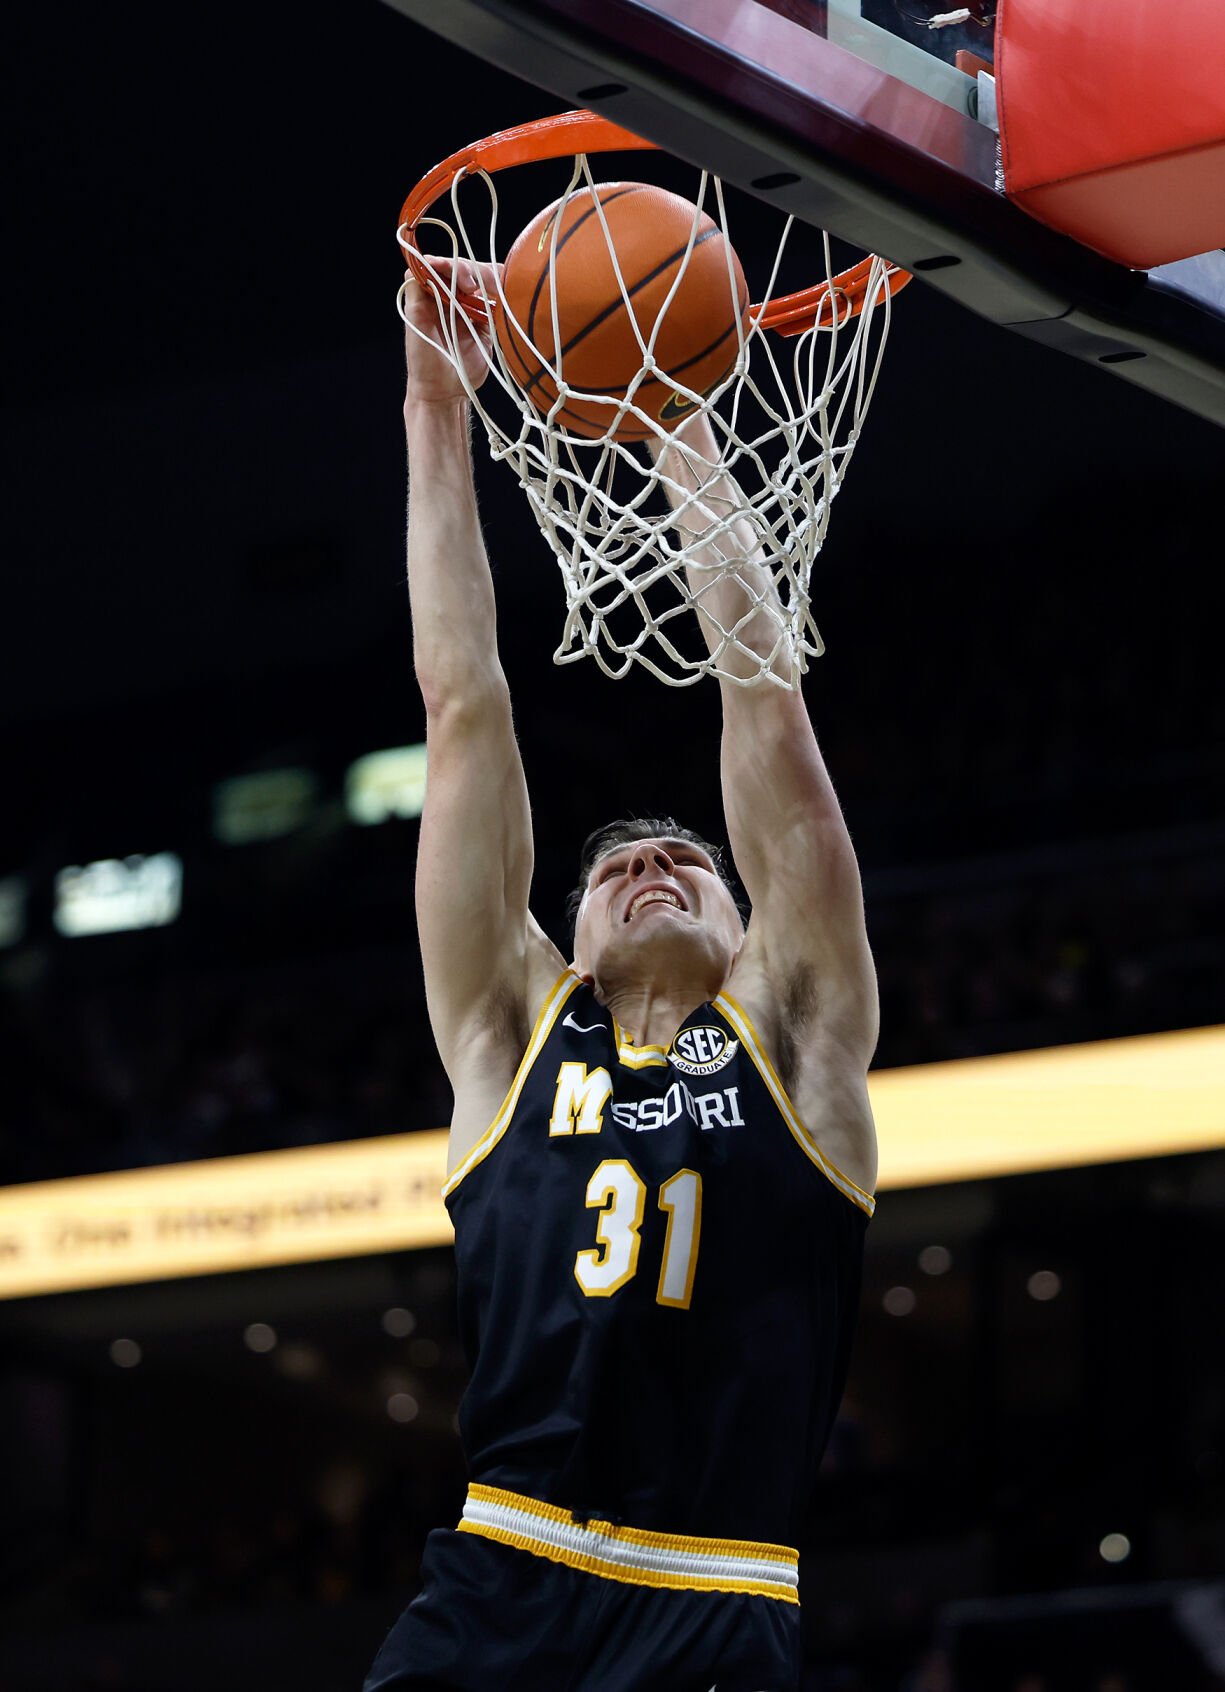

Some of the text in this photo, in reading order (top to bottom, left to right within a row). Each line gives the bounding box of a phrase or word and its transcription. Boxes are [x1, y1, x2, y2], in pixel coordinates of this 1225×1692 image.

[677, 1028, 723, 1063] SEC
[676, 1052, 732, 1075] GRADUATE
[574, 1159, 703, 1310] 31
